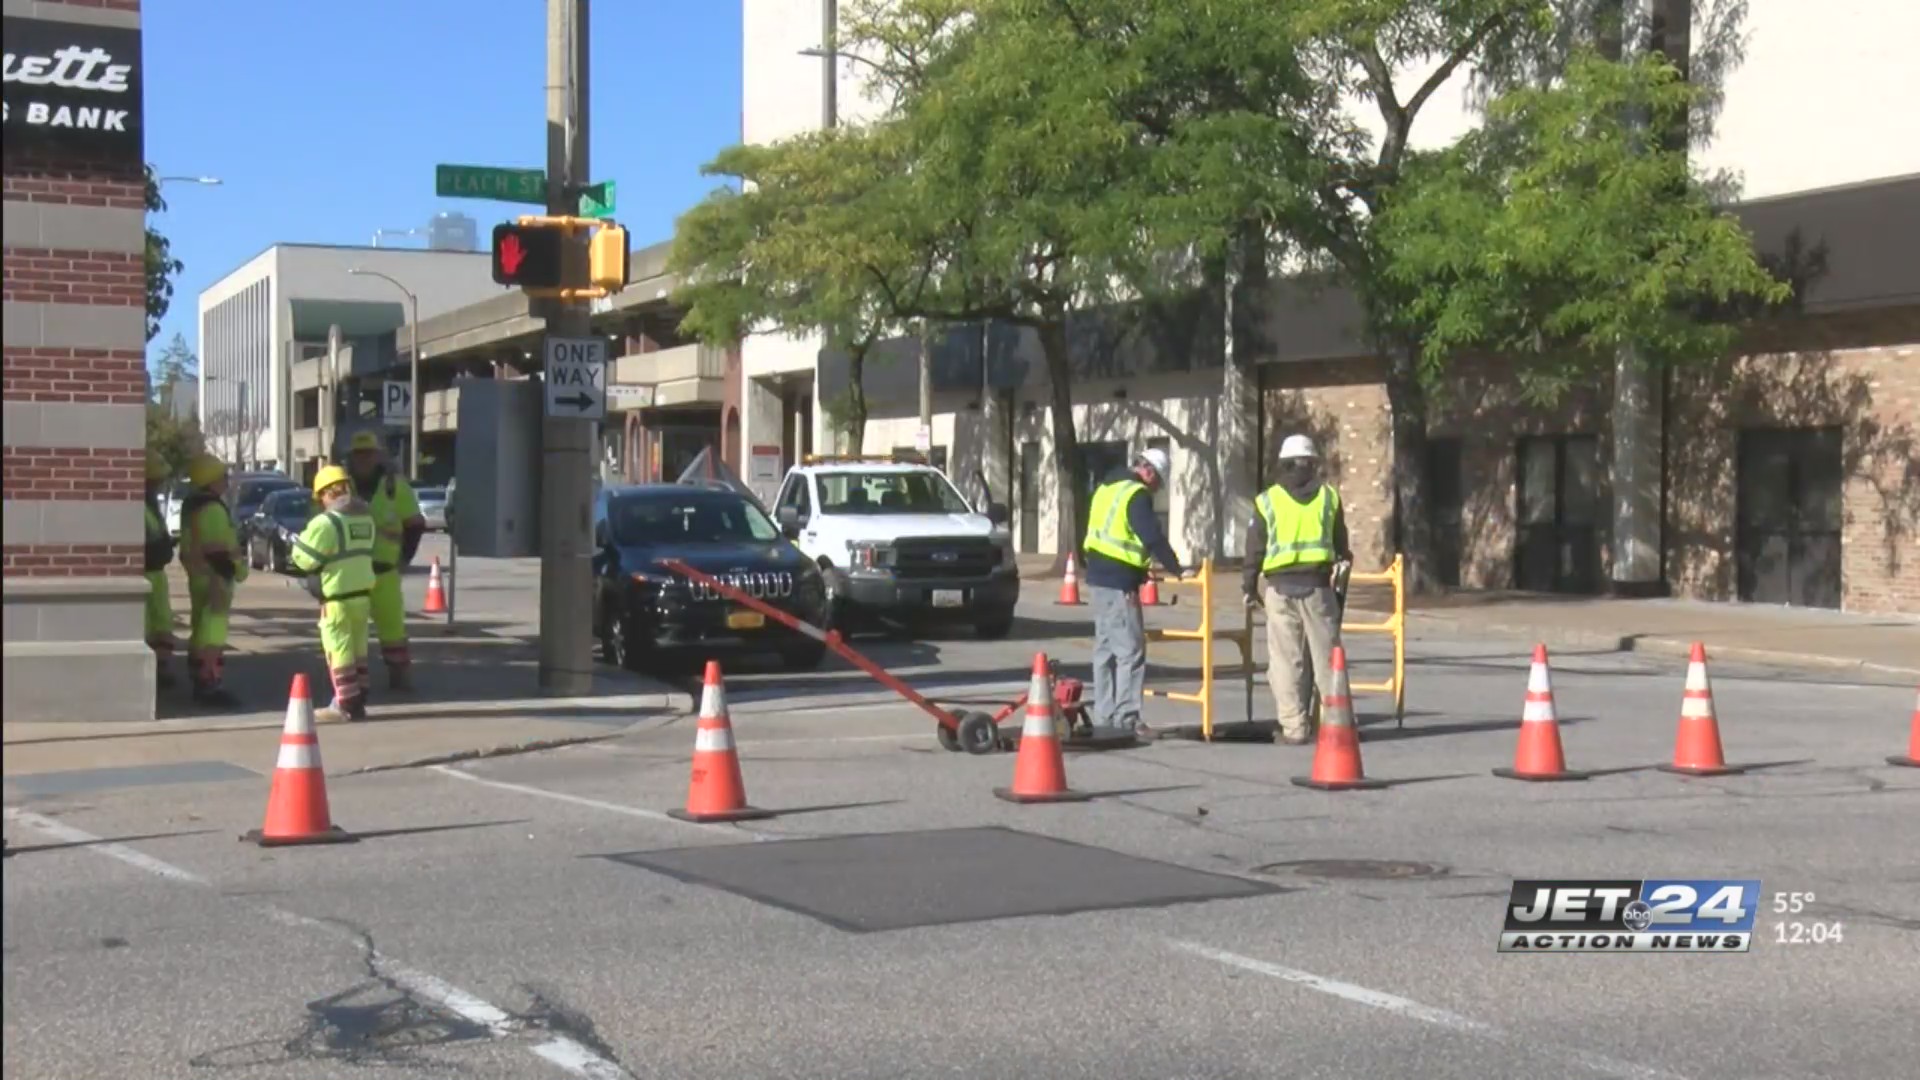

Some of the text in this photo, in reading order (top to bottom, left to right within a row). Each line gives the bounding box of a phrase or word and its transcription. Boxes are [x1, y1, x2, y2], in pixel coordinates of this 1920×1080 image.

[26, 102, 128, 132] BANK
[519, 176, 543, 197] ST
[554, 343, 599, 363] ONE
[552, 367, 600, 386] WAY
[387, 385, 401, 412] P
